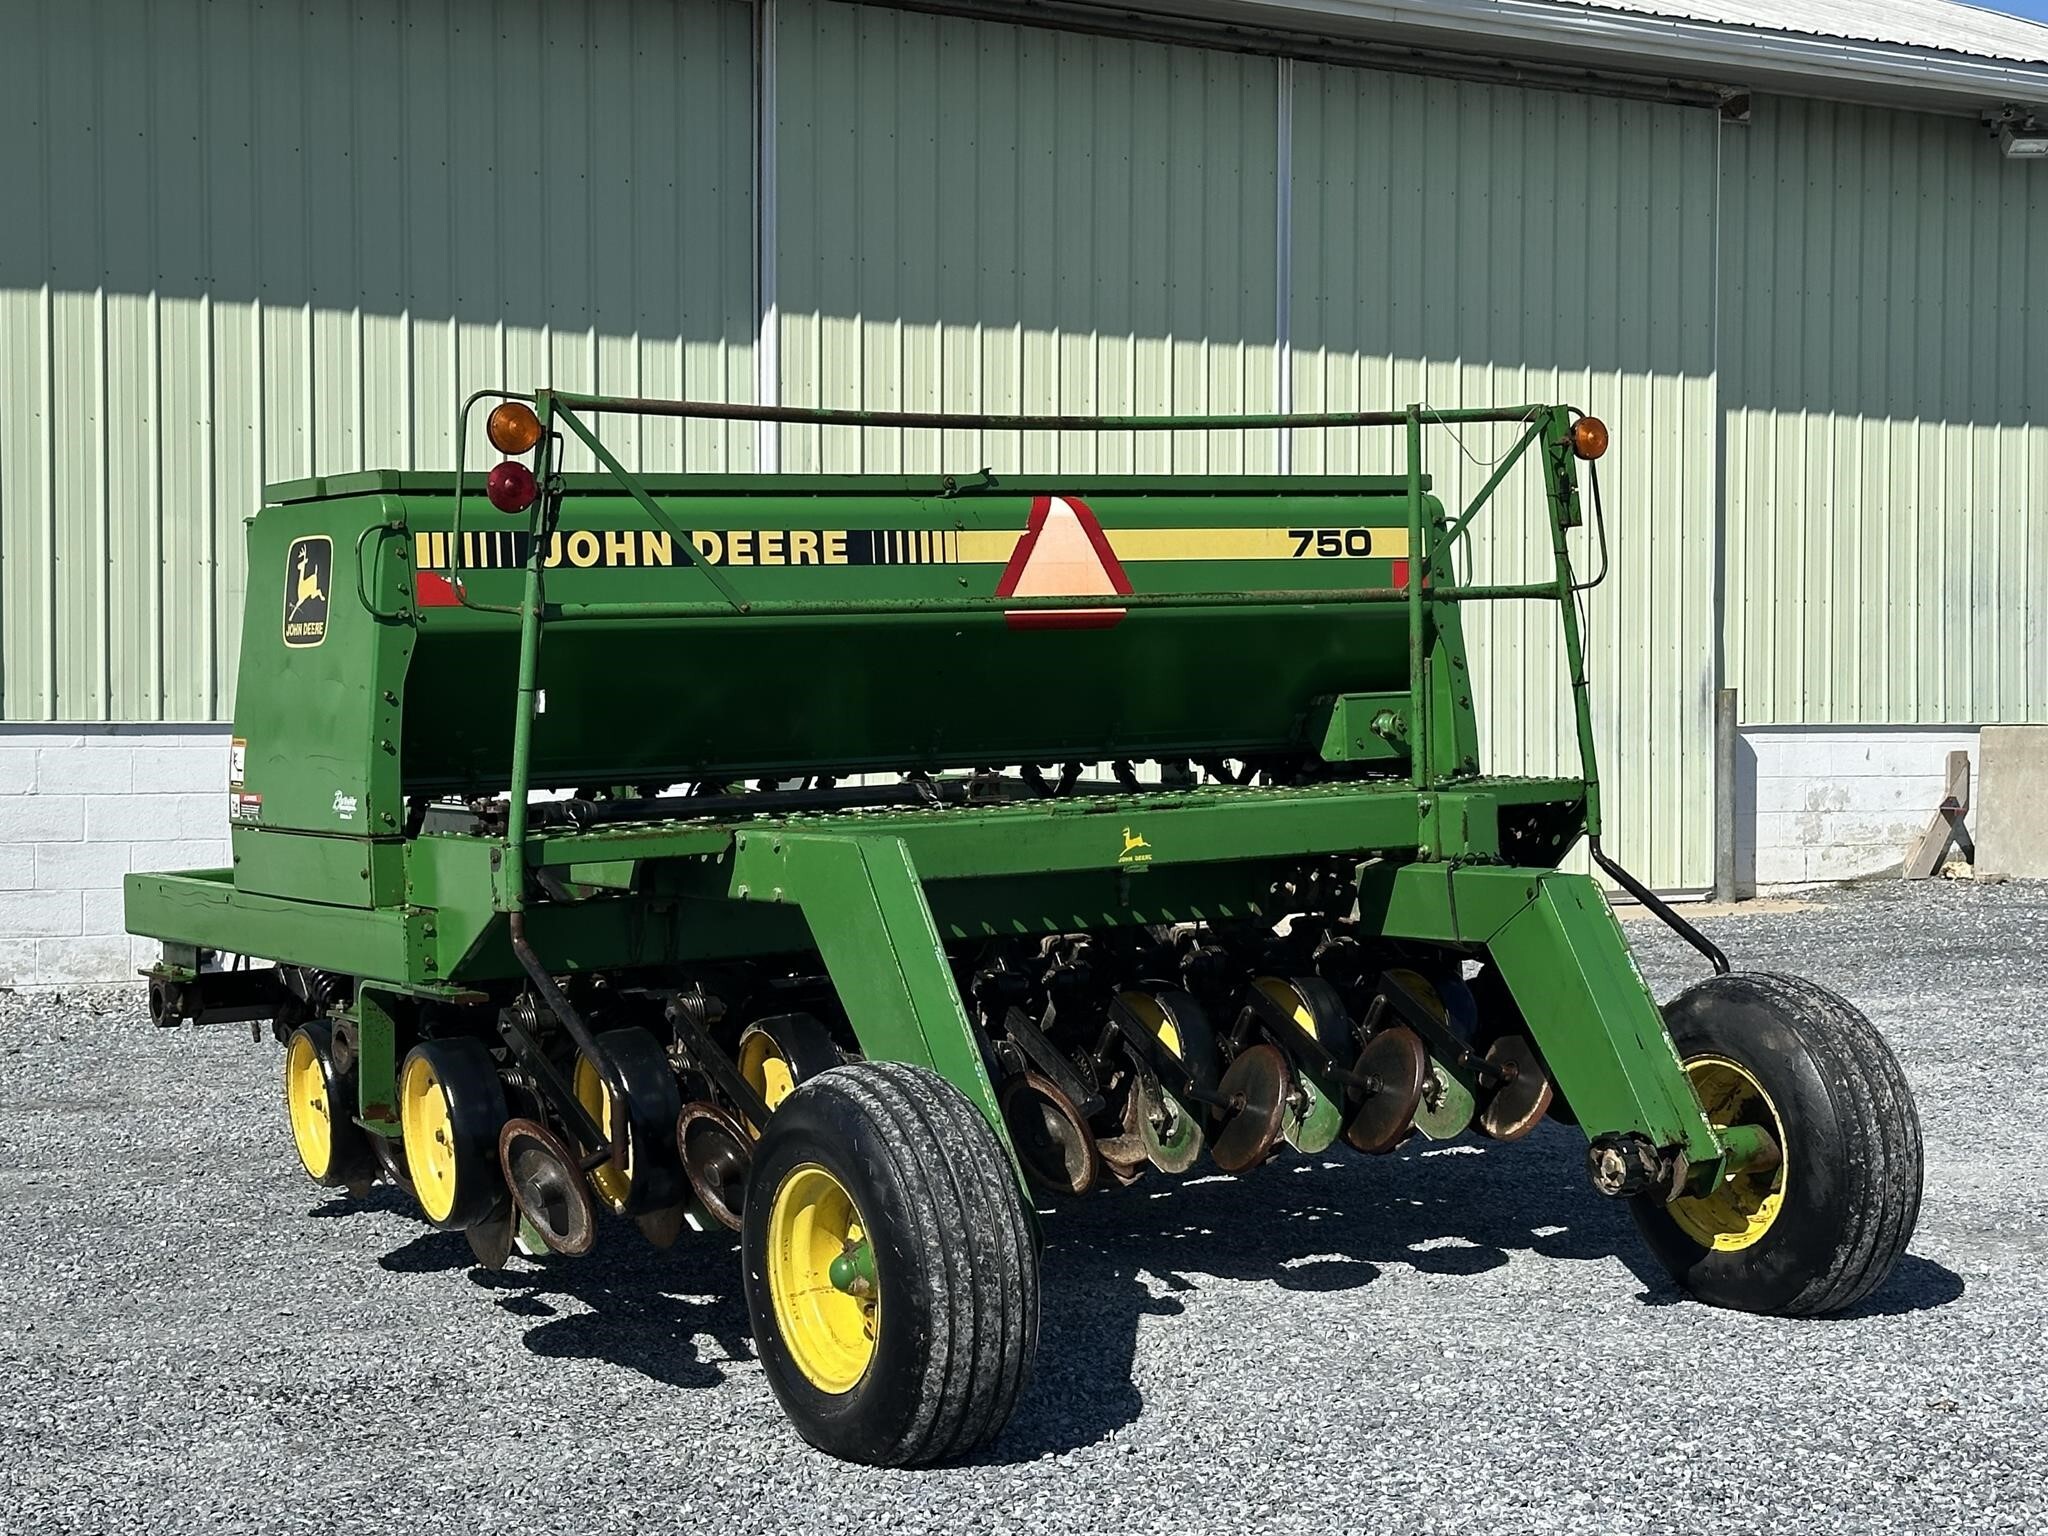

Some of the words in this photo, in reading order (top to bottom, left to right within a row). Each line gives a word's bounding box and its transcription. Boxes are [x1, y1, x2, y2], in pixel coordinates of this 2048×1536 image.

[543, 530, 673, 568] JOHN
[692, 530, 849, 566] DEERE
[1288, 529, 1372, 557] 750
[286, 623, 303, 637] JOHN
[303, 622, 324, 636] DEERE
